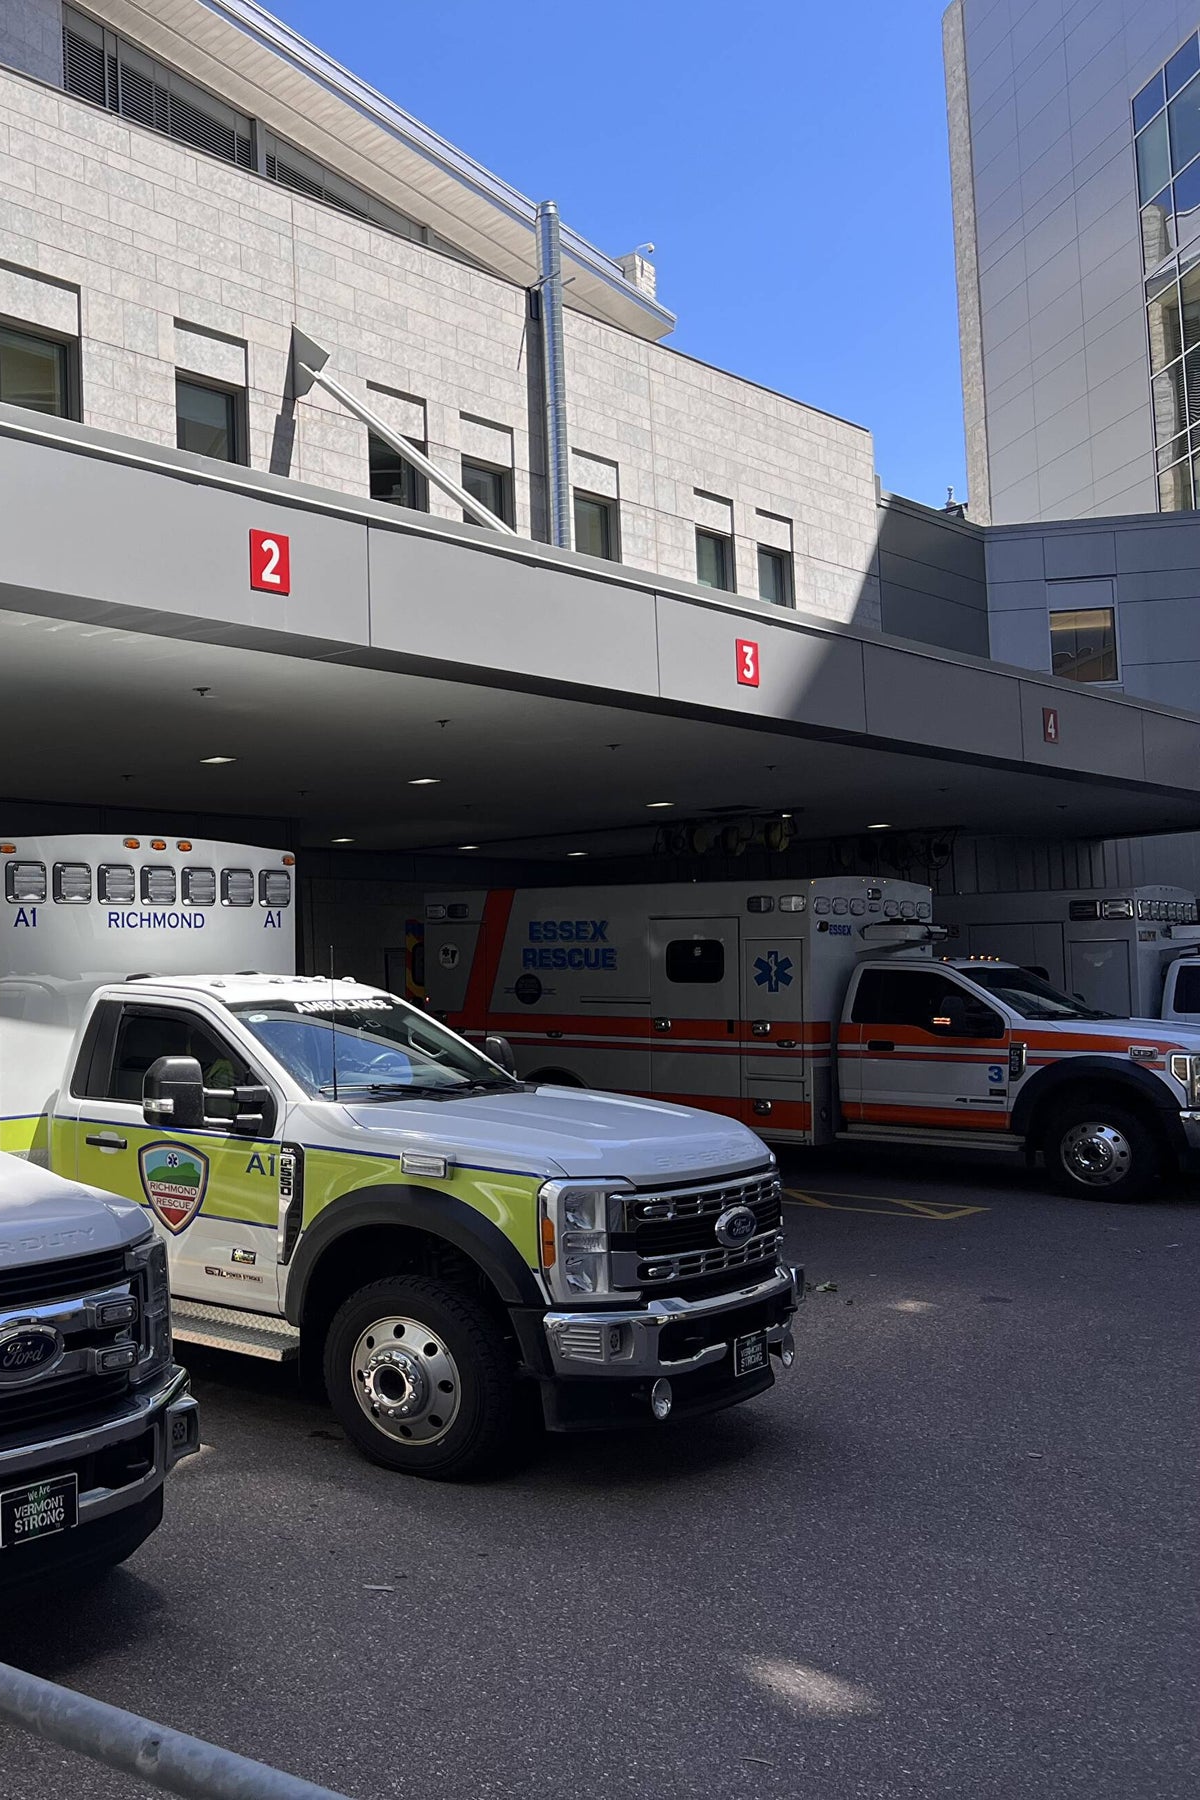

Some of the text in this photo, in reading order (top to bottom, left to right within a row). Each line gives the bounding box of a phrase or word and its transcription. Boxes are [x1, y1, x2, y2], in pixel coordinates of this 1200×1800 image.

[261, 539, 280, 584] 2
[743, 645, 754, 679] 3
[1048, 714, 1055, 738] 4
[14, 907, 37, 927] A1
[108, 912, 205, 929] RICHMOND
[264, 910, 282, 928] A1
[529, 920, 608, 943] ESSEX
[829, 924, 851, 936] ESSEX
[522, 948, 617, 970] RESCUE
[294, 999, 393, 1013] AMBULANCE
[988, 1066, 1004, 1083] 3
[245, 1151, 276, 1177] A1
[150, 1182, 197, 1196] RICHMOND
[156, 1197, 191, 1210] RESCUE
[19, 1227, 95, 1250] DUTY
[3, 1342, 44, 1367] Ford
[27, 1485, 51, 1502] We Are
[14, 1494, 64, 1518] VERMONT
[14, 1507, 65, 1533] STRONG
